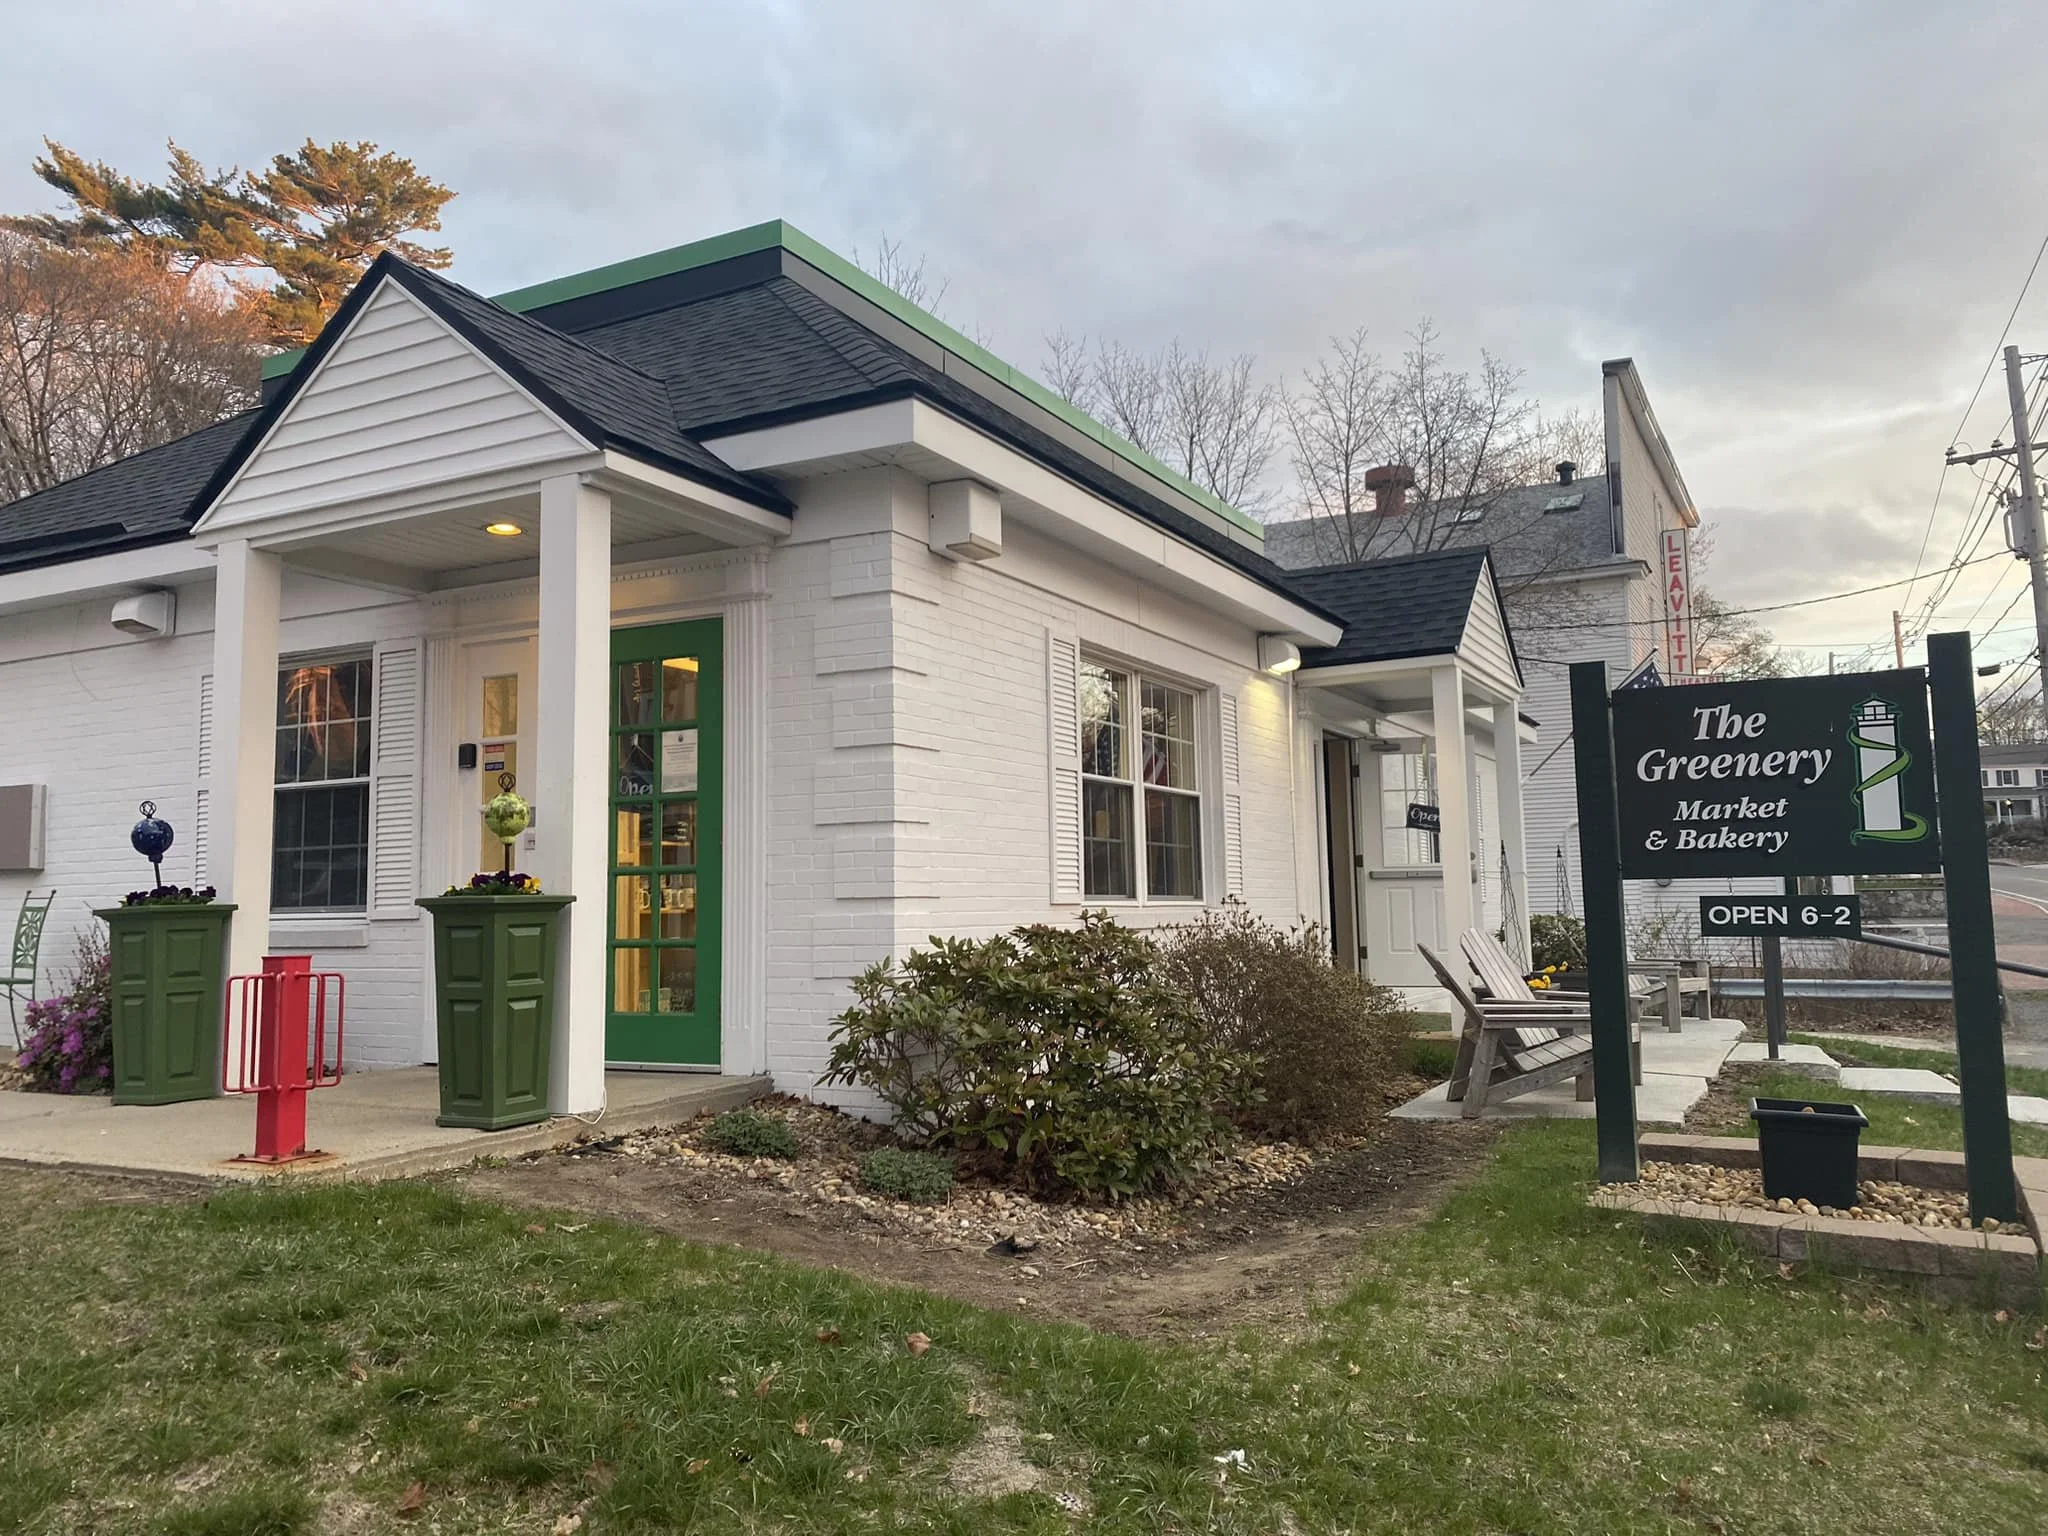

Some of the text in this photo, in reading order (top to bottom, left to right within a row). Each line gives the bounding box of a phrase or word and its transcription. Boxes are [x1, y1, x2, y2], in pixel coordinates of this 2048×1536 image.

[1667, 535, 1688, 673] LEAVITT
[1693, 703, 1767, 741] The
[1636, 747, 1832, 785] Greenery
[1673, 797, 1789, 821] Market
[1644, 826, 1789, 854] & Bakery
[1708, 905, 1851, 925] OPEN 6-2
